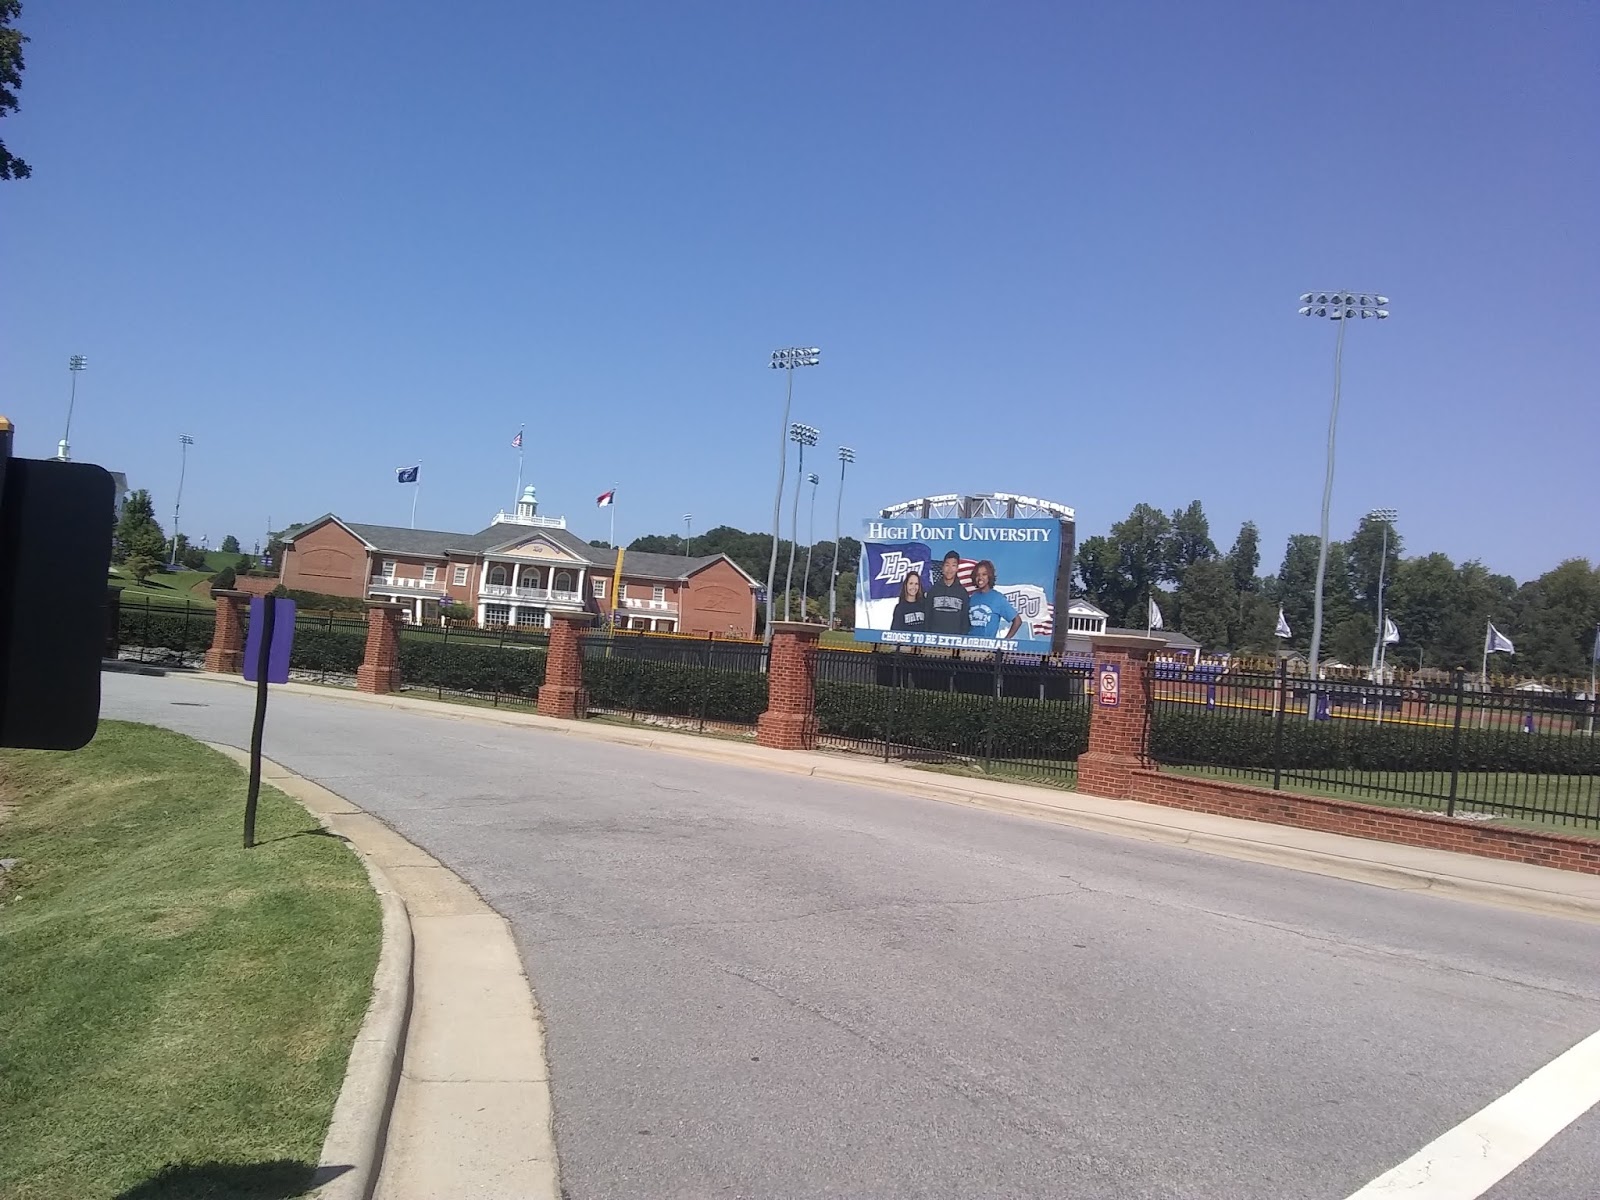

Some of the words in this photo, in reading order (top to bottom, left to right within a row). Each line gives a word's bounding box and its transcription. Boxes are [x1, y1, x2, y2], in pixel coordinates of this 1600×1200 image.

[958, 523, 1052, 542] UNIVERSITY
[881, 631, 911, 643] CHOOSE
[913, 633, 925, 644] TO
[926, 634, 938, 645] BE
[937, 635, 1018, 651] EXTRAORDINARY!
